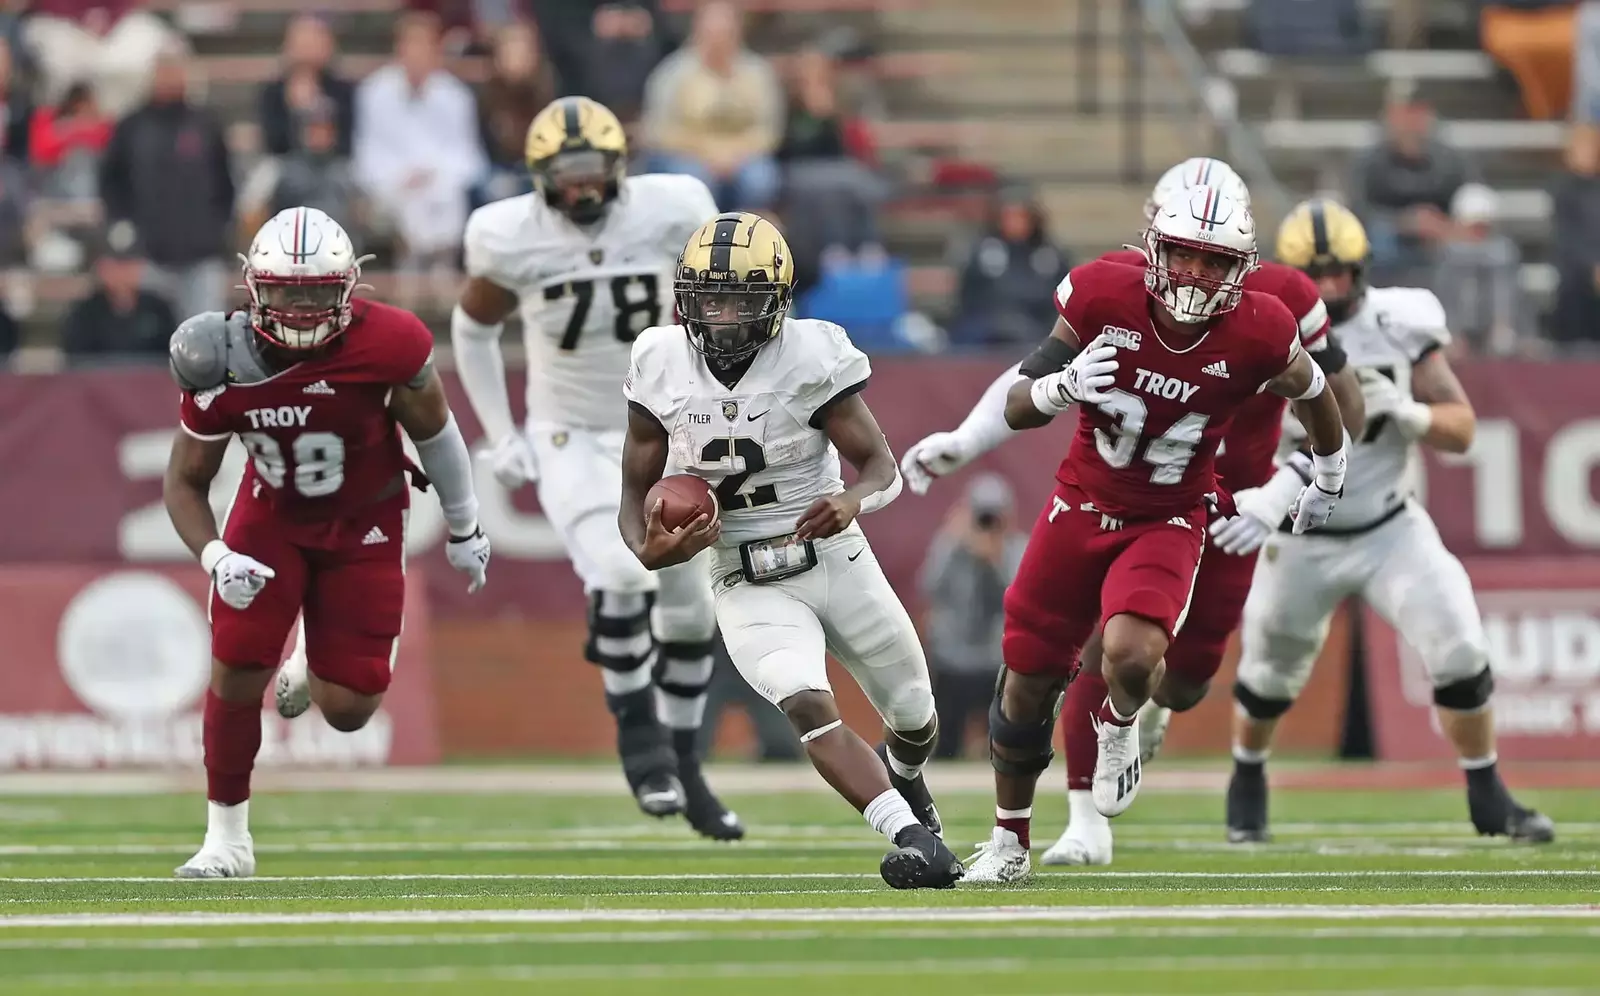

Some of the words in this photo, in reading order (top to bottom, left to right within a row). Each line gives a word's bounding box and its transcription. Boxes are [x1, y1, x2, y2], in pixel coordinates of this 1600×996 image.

[708, 271, 728, 280] ARMY
[543, 273, 660, 351] 78
[1133, 368, 1200, 403] TROY
[1201, 366, 1230, 379] adidas
[244, 405, 312, 429] TROY
[687, 413, 711, 424] TYLER
[1093, 387, 1210, 485] 34
[699, 436, 779, 512] 2
